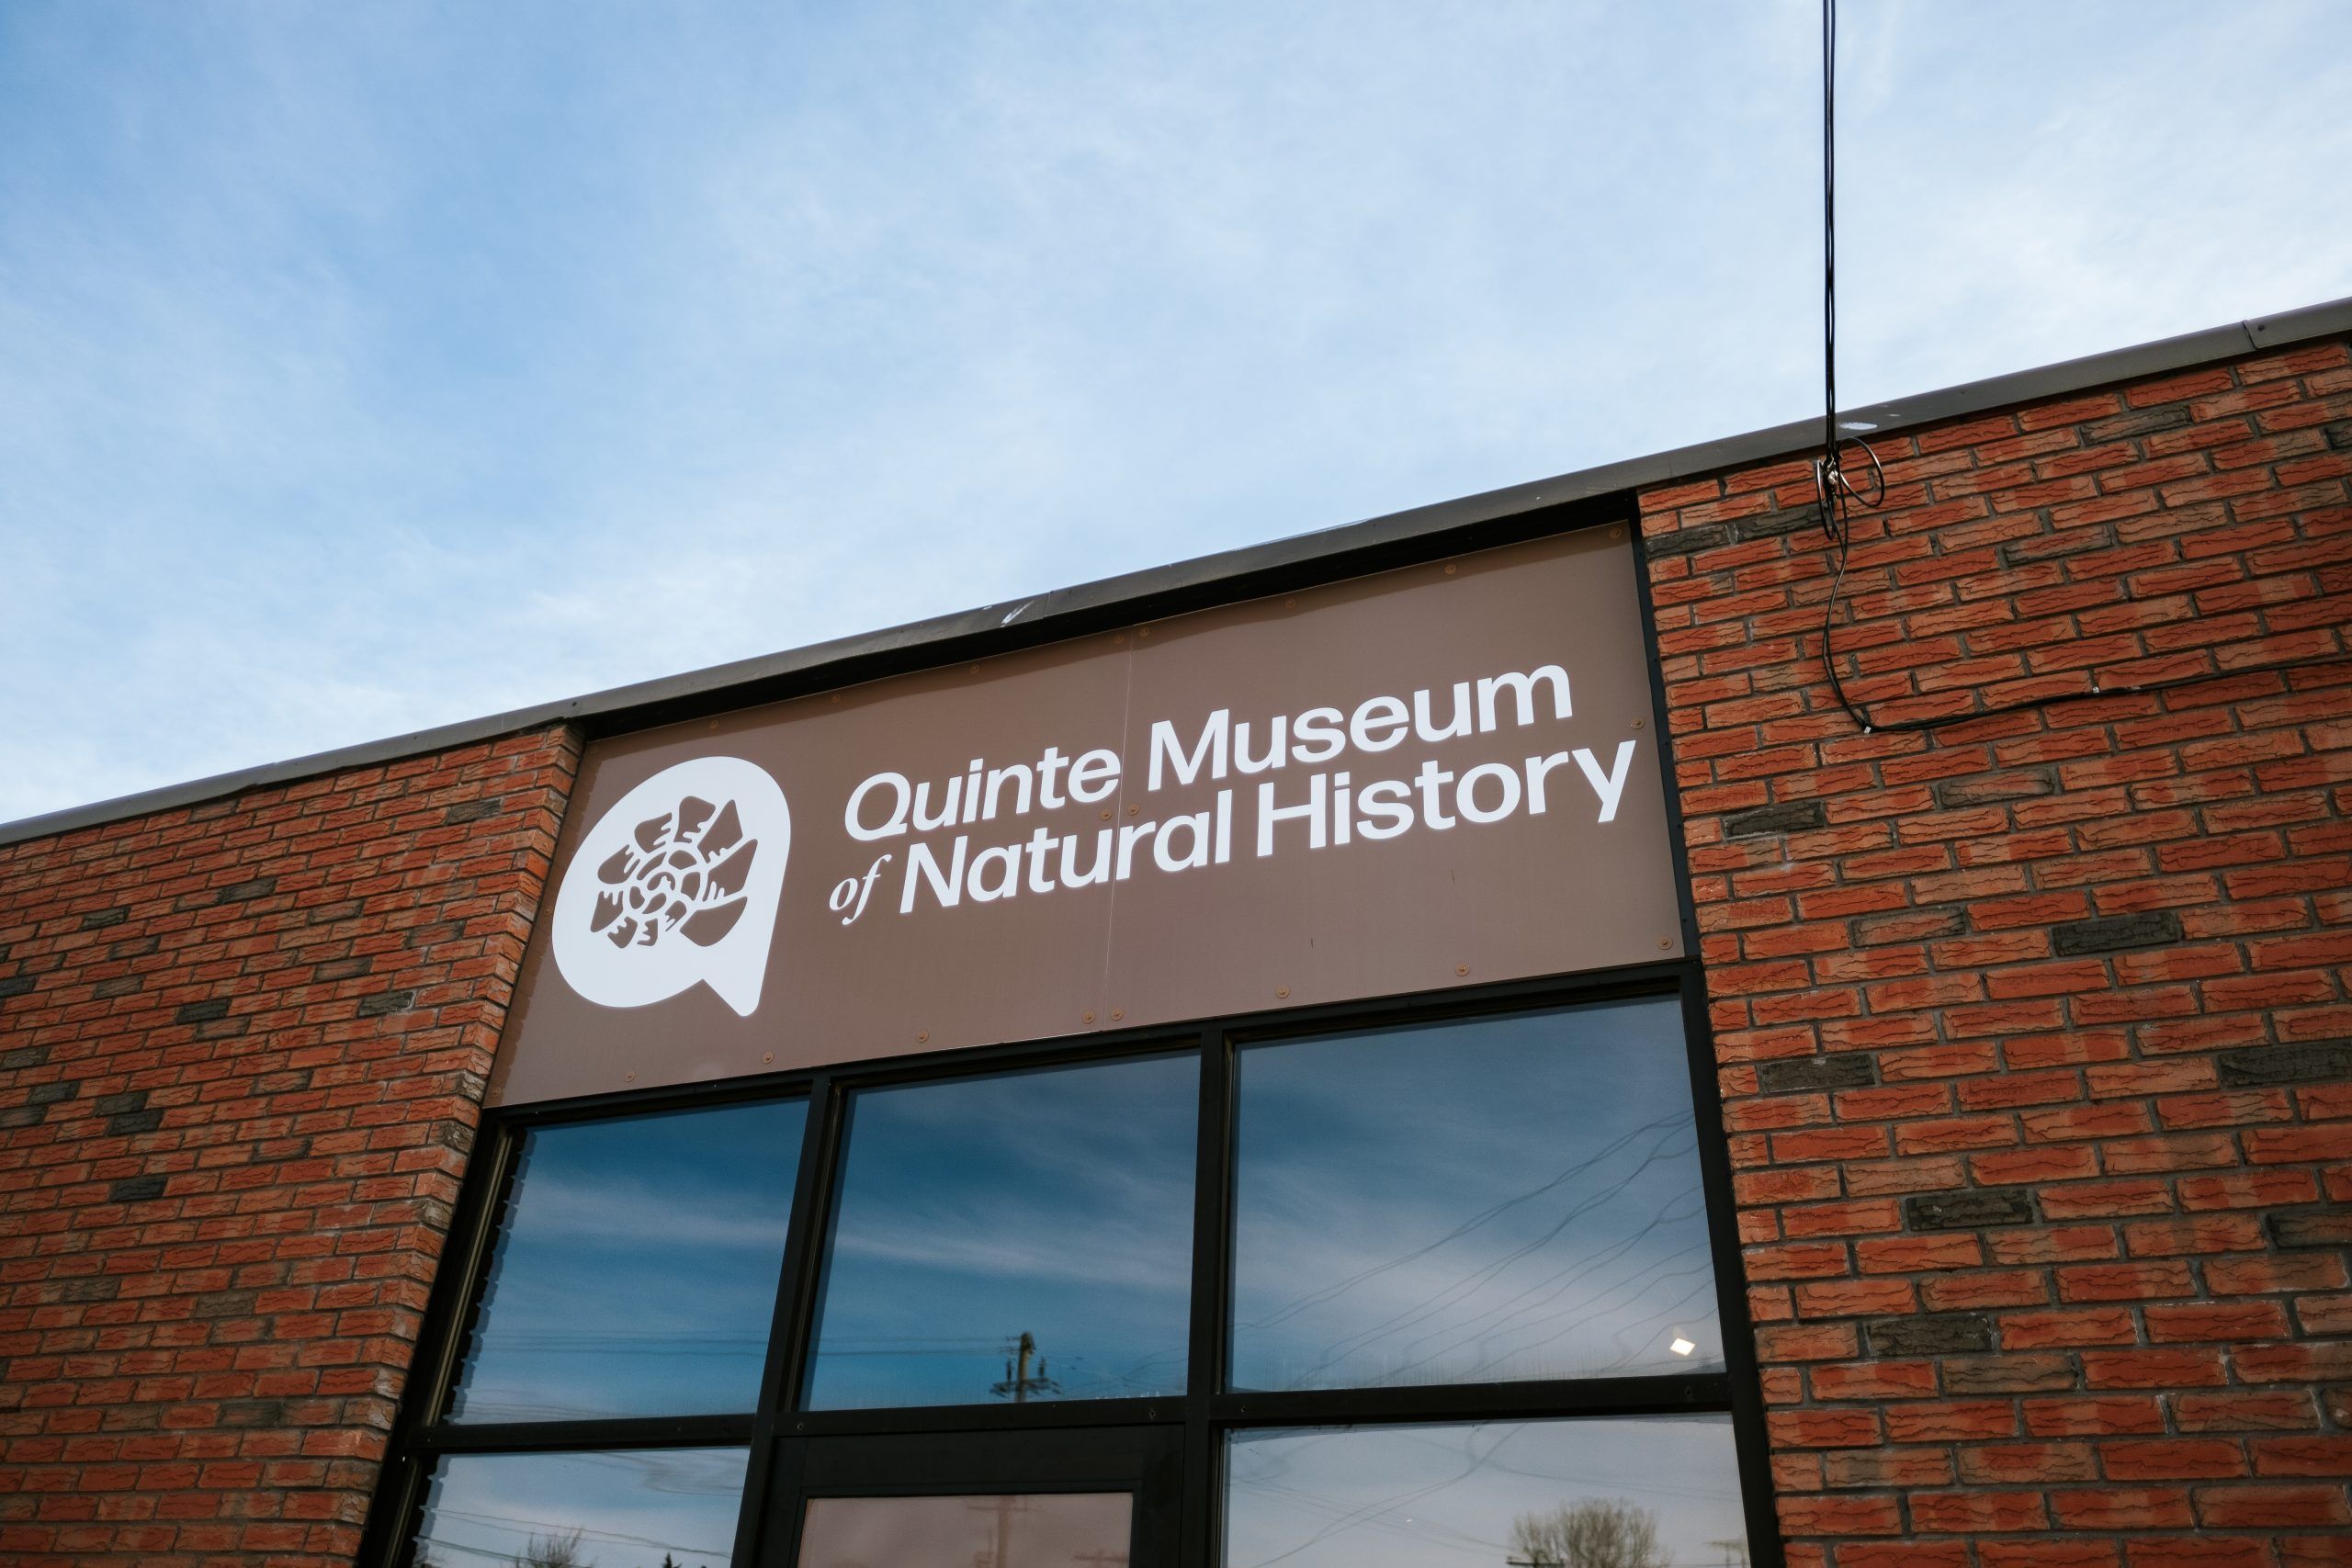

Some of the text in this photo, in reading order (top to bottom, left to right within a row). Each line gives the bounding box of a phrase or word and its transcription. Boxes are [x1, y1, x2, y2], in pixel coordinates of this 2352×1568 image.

[829, 739, 1636, 927] of Natural History
[843, 664, 1573, 842] Quinte Museum
